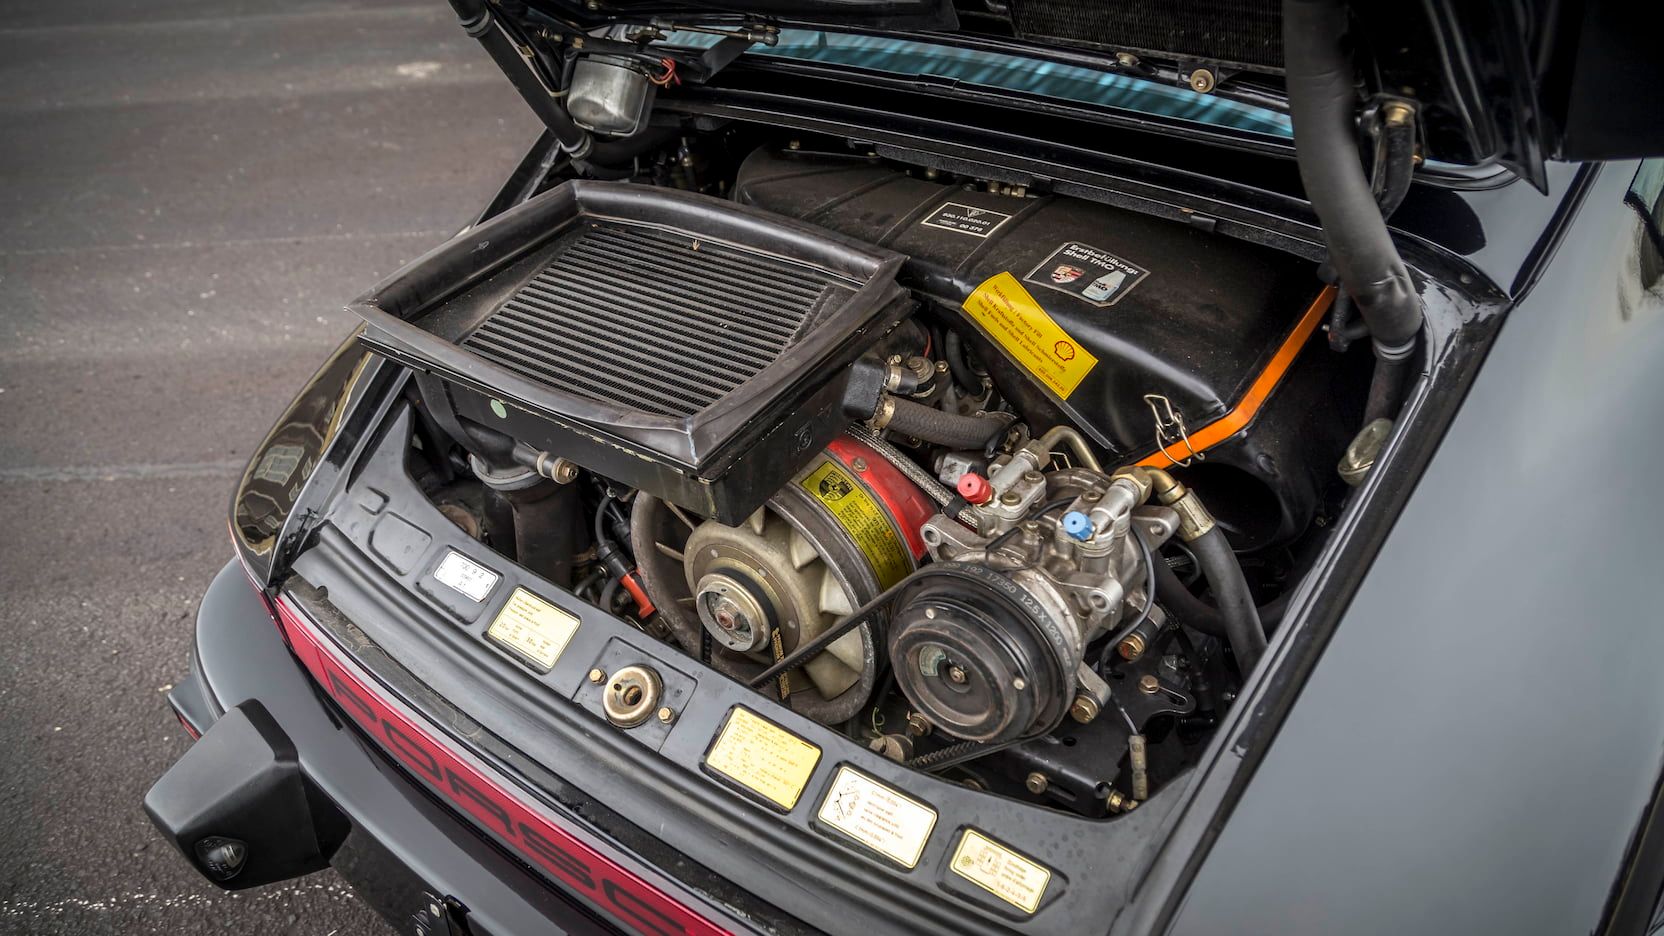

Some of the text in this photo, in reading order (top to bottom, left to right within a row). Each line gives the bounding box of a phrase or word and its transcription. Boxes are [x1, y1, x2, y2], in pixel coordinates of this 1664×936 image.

[1063, 249, 1115, 271] Shell TMO
[1069, 244, 1140, 275] Erstbefüllung:
[987, 573, 1017, 594] 17350
